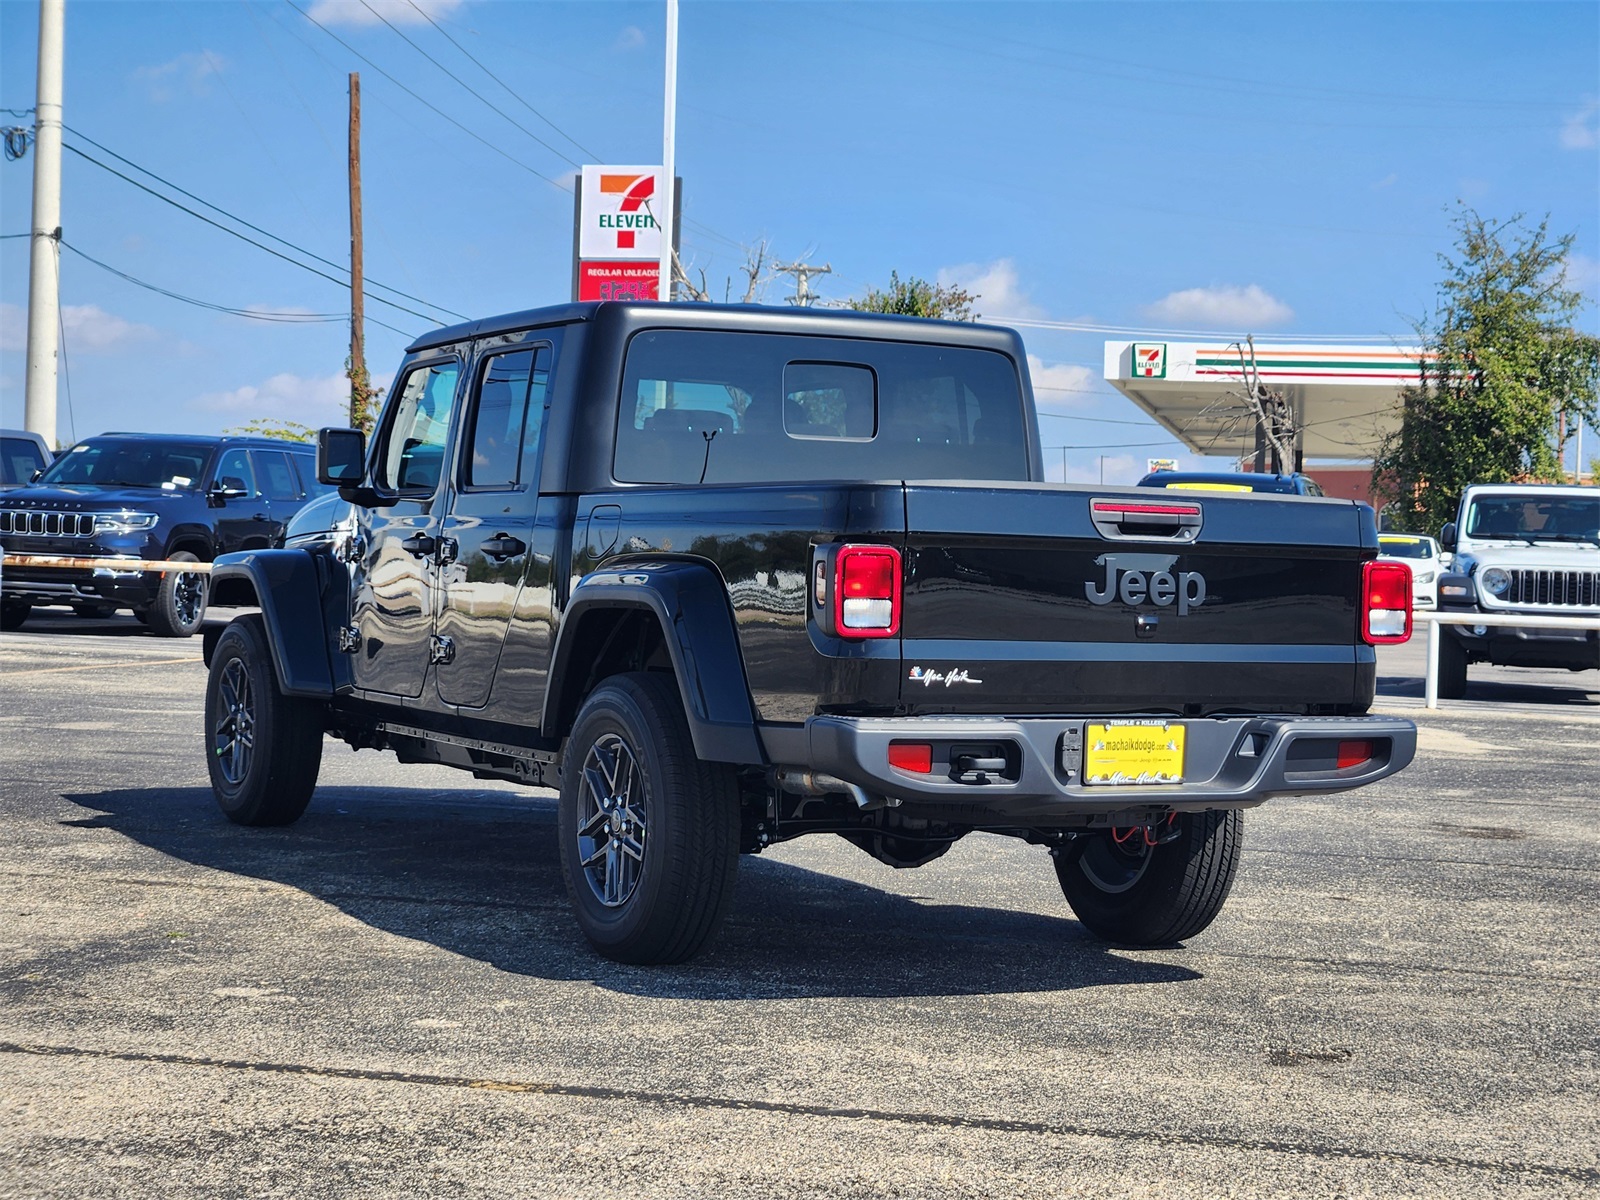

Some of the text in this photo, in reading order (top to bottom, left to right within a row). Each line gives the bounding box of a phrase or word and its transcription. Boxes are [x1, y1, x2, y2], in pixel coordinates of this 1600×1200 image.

[587, 268, 622, 277] REGULAR
[1085, 557, 1206, 617] Jeep
[1105, 739, 1165, 753] machaikdodge.com
